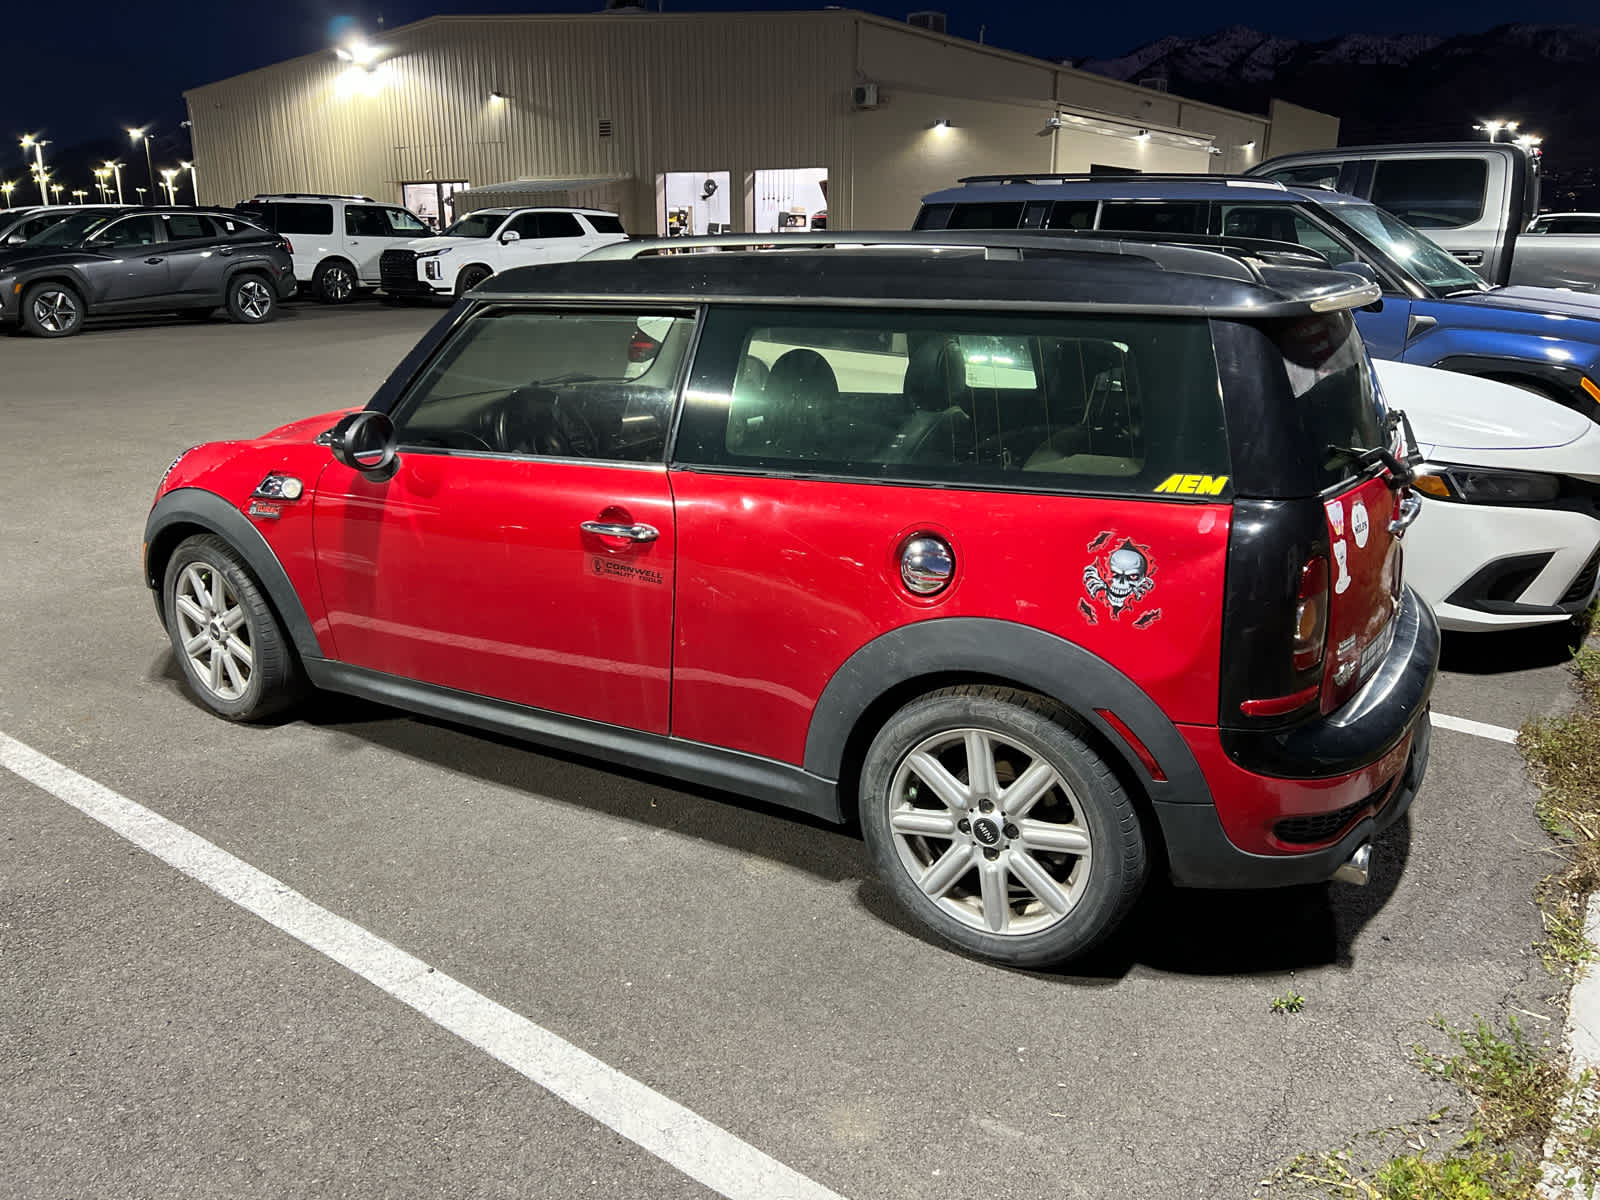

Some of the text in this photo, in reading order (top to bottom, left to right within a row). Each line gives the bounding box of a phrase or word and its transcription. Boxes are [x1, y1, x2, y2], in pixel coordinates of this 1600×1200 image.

[1153, 473, 1229, 495] AEM
[605, 561, 664, 578] CORNWELL
[977, 822, 995, 842] MINI
